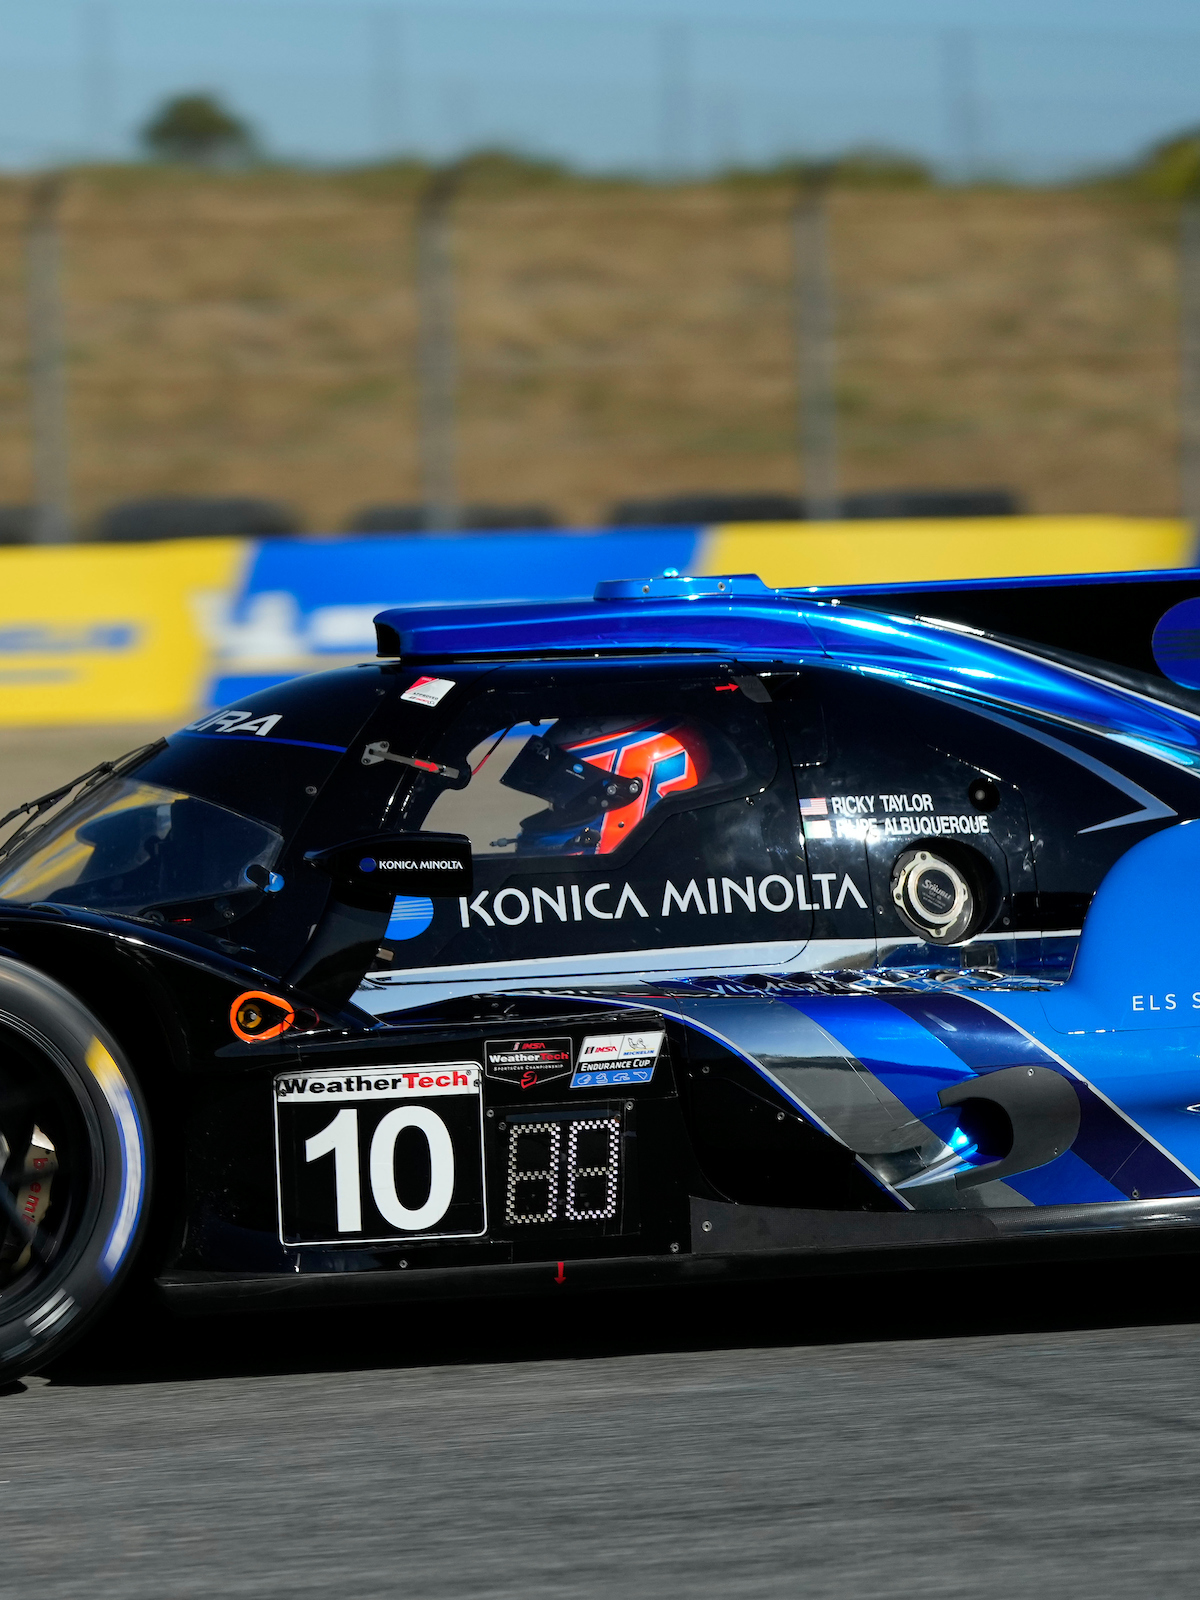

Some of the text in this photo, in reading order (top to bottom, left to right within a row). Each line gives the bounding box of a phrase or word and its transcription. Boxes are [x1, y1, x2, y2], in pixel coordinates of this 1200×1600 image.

[831, 793, 934, 815] RICKY TAYLOR
[884, 815, 990, 836] ALBUQUERQUE
[379, 860, 463, 870] KONICA MINOLTA
[458, 881, 650, 928] KONICA
[660, 873, 869, 917] MINOLTA
[1132, 993, 1177, 1011] ELS
[489, 1052, 569, 1063] WeatherTech
[580, 1058, 651, 1072] ENDURANCE CUP
[284, 1071, 469, 1094] WeatherTech
[305, 1104, 455, 1234] 10
